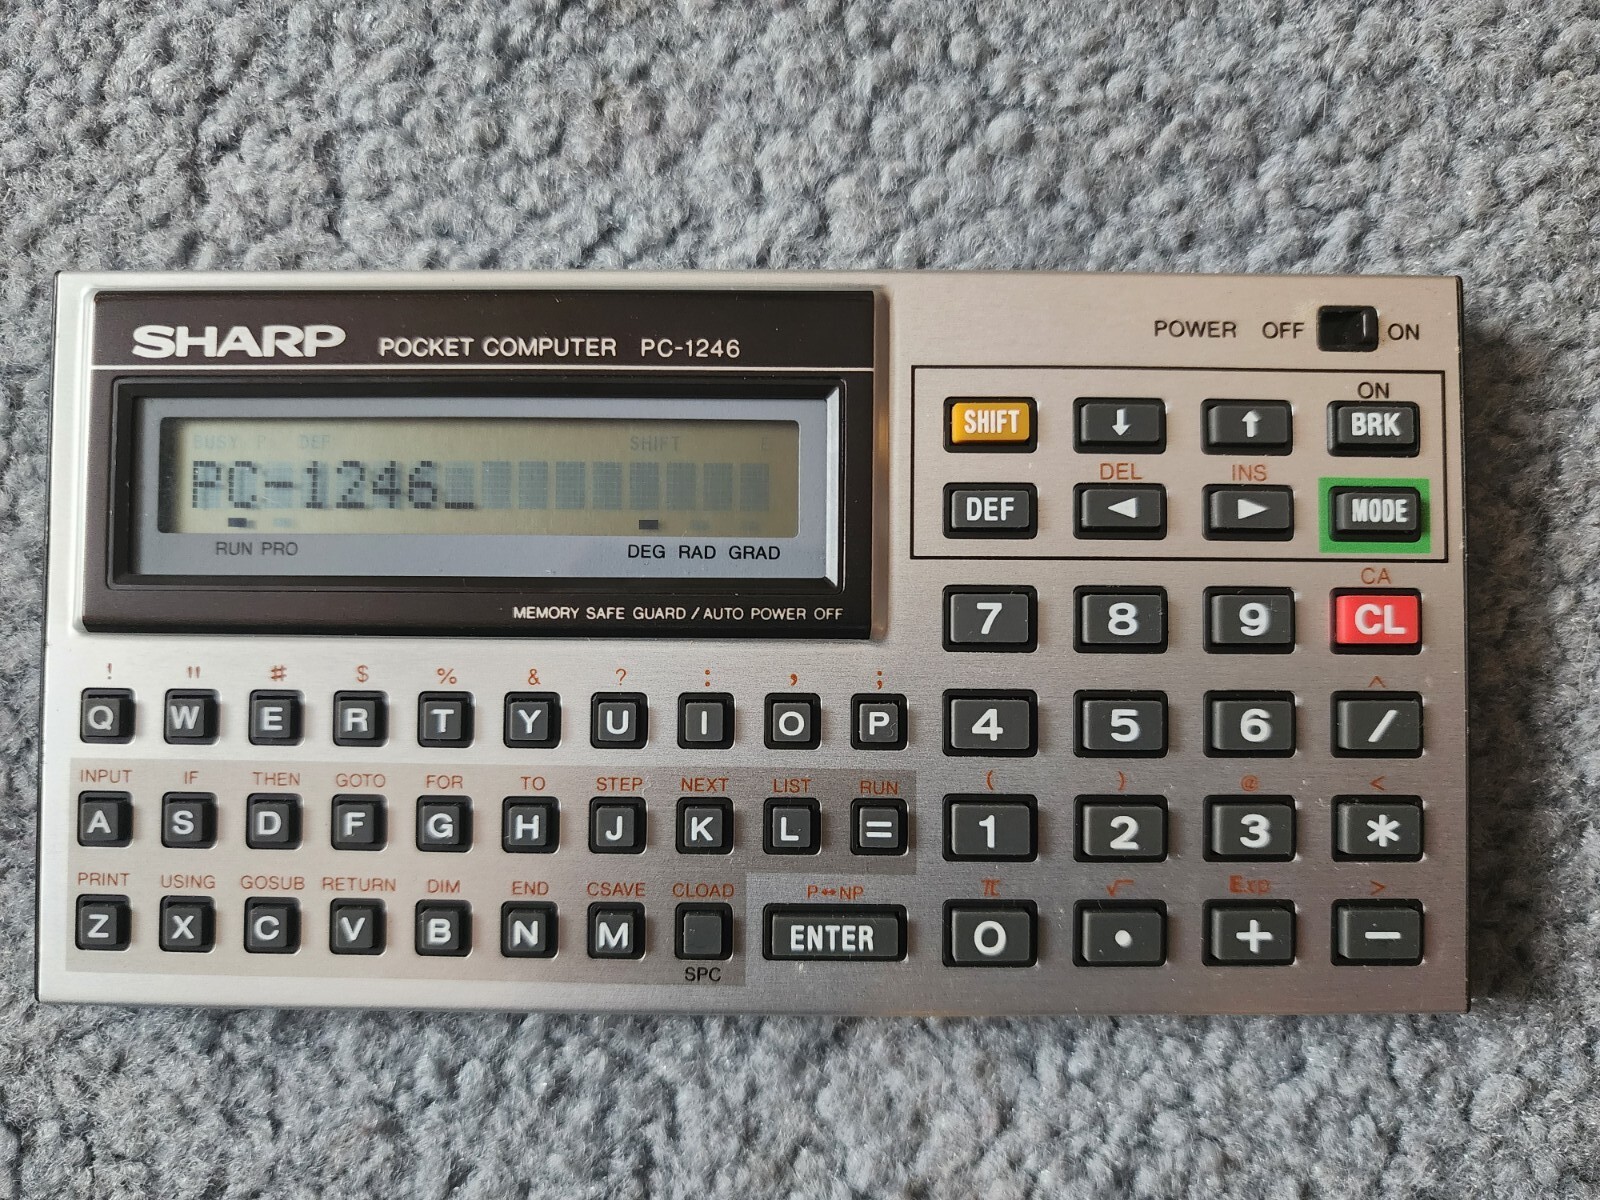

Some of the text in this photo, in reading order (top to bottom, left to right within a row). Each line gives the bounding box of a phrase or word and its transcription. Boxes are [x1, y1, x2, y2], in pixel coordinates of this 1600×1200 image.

[1155, 320, 1304, 339] POWER OFF
[1388, 323, 1419, 340] ON
[132, 325, 346, 358] SHARP
[379, 337, 739, 358] POCKET COMPUTER PC-1246
[1357, 381, 1390, 400] ON
[964, 410, 1019, 433] SHIFT
[1352, 412, 1400, 436] BRK
[1100, 463, 1143, 481] DEL
[1231, 465, 1267, 482] INS
[967, 497, 1014, 521] DEF
[1352, 499, 1408, 522] MODE
[216, 541, 298, 556] RUN PRO
[628, 545, 780, 559] DEG RAD GRAD
[1360, 568, 1392, 585] CA
[513, 607, 579, 619] MEMORY
[586, 607, 624, 619] SAFE
[633, 607, 686, 619] GUARD
[704, 608, 743, 620] AUTO
[751, 608, 806, 620] POWER
[814, 608, 843, 620] OFF
[977, 603, 1002, 634] 7
[1108, 603, 1138, 635] 8
[1239, 603, 1269, 636] 9
[1355, 604, 1406, 634] CL
[88, 706, 113, 730] Q
[170, 706, 199, 729] W
[262, 707, 282, 730] E
[345, 708, 367, 731] R
[431, 709, 454, 732] T
[518, 710, 541, 733] Y
[607, 710, 628, 734] U
[702, 711, 707, 734] I
[779, 712, 804, 735] O
[870, 712, 889, 735] P
[972, 709, 1003, 741] 4
[1111, 709, 1140, 742] 5
[1241, 709, 1271, 742] 6
[1368, 710, 1397, 742] /
[81, 769, 132, 783] INPUT
[185, 771, 198, 784] IF
[253, 772, 300, 786] THEN
[336, 773, 385, 788] GOTO
[427, 775, 463, 789] FOR
[521, 777, 545, 790] TO
[597, 777, 642, 791] STEP
[682, 777, 729, 791] NEXT
[774, 779, 813, 793] LIST
[860, 780, 898, 796] RUN
[87, 810, 111, 833] A
[173, 811, 194, 834] S
[257, 811, 281, 835] D
[344, 812, 365, 835] F
[427, 813, 453, 838] G
[516, 815, 539, 839] H
[606, 816, 622, 840] J
[692, 817, 713, 841] K
[781, 817, 799, 841] L
[866, 821, 892, 837] =
[979, 815, 994, 848] 1
[1110, 816, 1138, 849] 2
[1240, 814, 1270, 848] 3
[78, 872, 129, 886] PRINT
[161, 875, 215, 889] USING
[241, 875, 305, 890] GOSUB
[322, 877, 395, 891] RETURN
[428, 879, 460, 893] DIM
[512, 881, 549, 896] END
[587, 882, 645, 896] CSAVE
[672, 883, 734, 898] CLOAD
[1229, 875, 1270, 896] Exp
[88, 914, 108, 938] Z
[172, 916, 194, 939] X
[254, 916, 279, 940] C
[341, 917, 365, 941] V
[428, 919, 451, 944] B
[513, 921, 538, 946] N
[599, 922, 628, 948] M
[1236, 920, 1273, 953] +
[791, 925, 873, 951] ENTER
[685, 967, 721, 982] SPC
